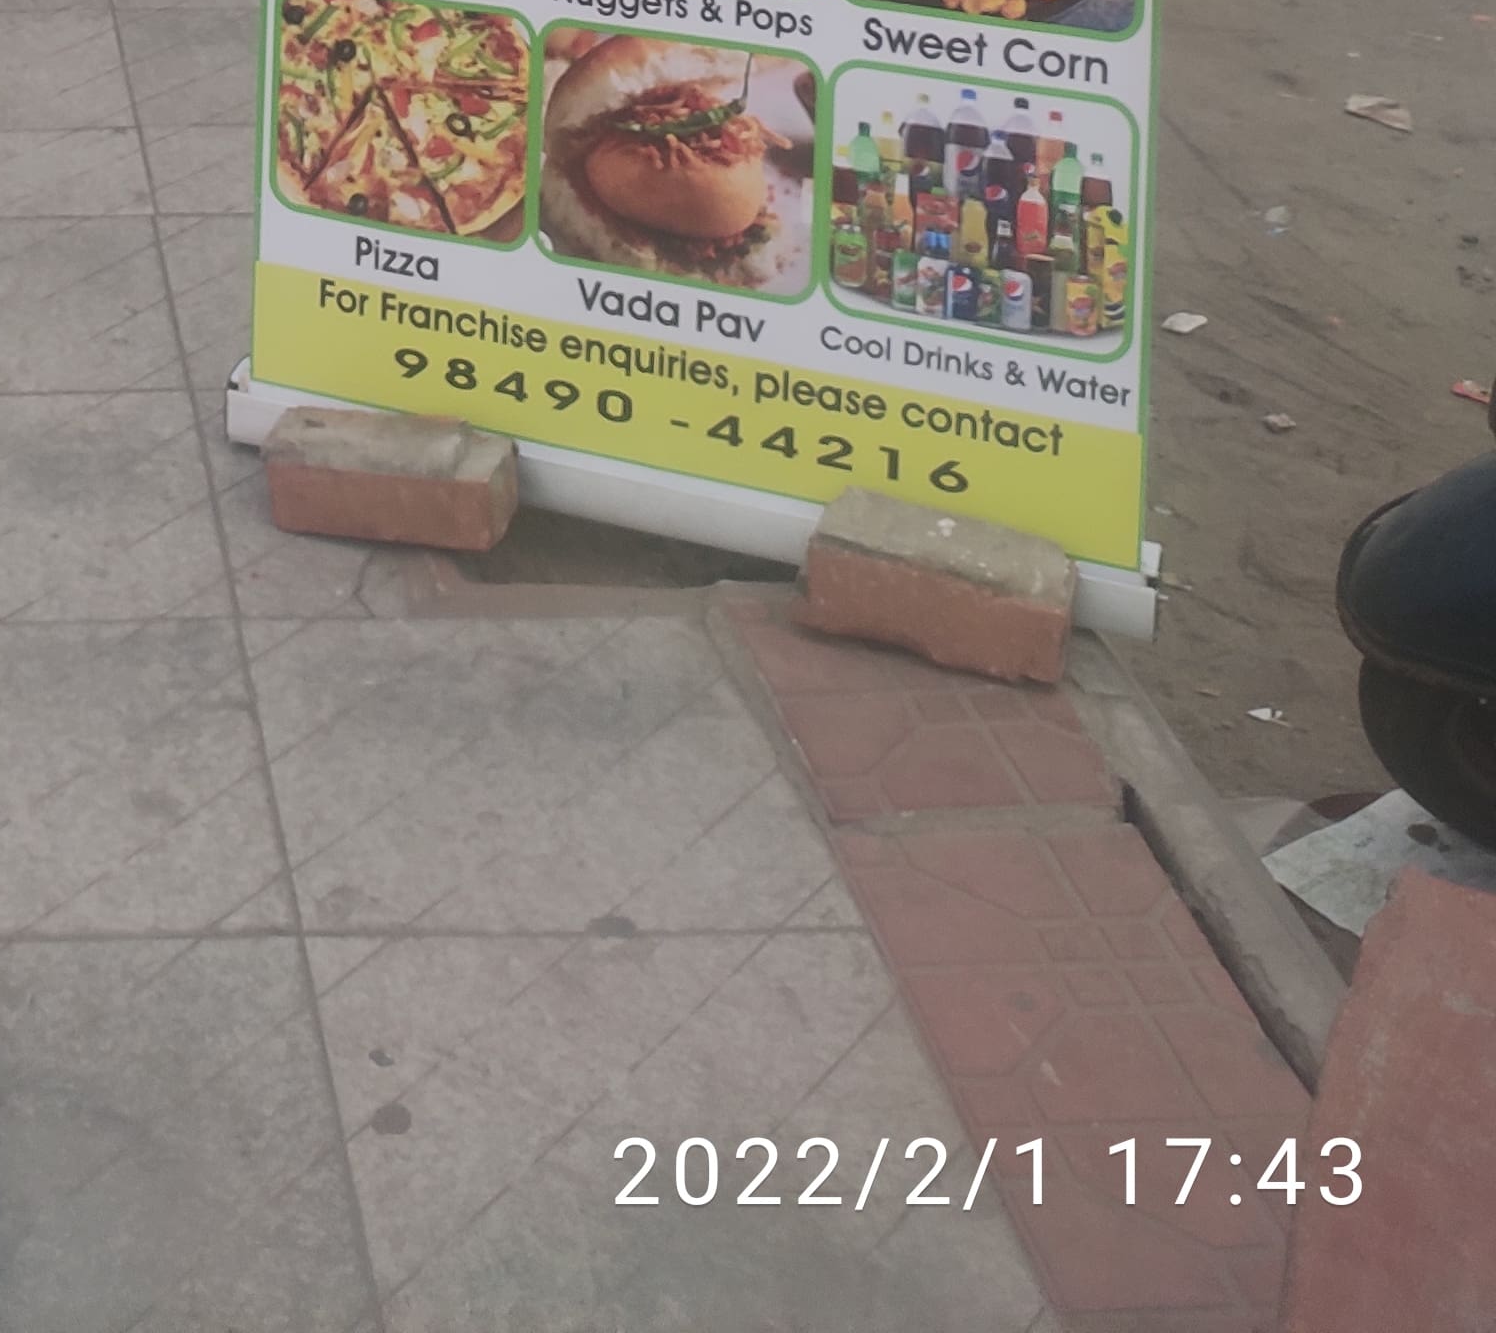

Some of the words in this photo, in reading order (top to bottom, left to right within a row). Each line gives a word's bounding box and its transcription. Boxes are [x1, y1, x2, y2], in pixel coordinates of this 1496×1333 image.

[862, 16, 988, 67] Sweet
[1002, 36, 1109, 85] Corn
[354, 235, 439, 282] Pizza
[576, 277, 680, 329] Vada
[696, 299, 766, 343] Pav
[318, 278, 369, 316] For
[380, 291, 548, 353] Franchise
[559, 331, 740, 397] enquiries,
[753, 370, 888, 421] please
[900, 400, 1064, 457] contact
[393, 347, 634, 423] 98490
[819, 325, 892, 362] Cool
[903, 340, 994, 382] Drinks
[1004, 360, 1027, 387] &
[1037, 365, 1131, 407] Water
